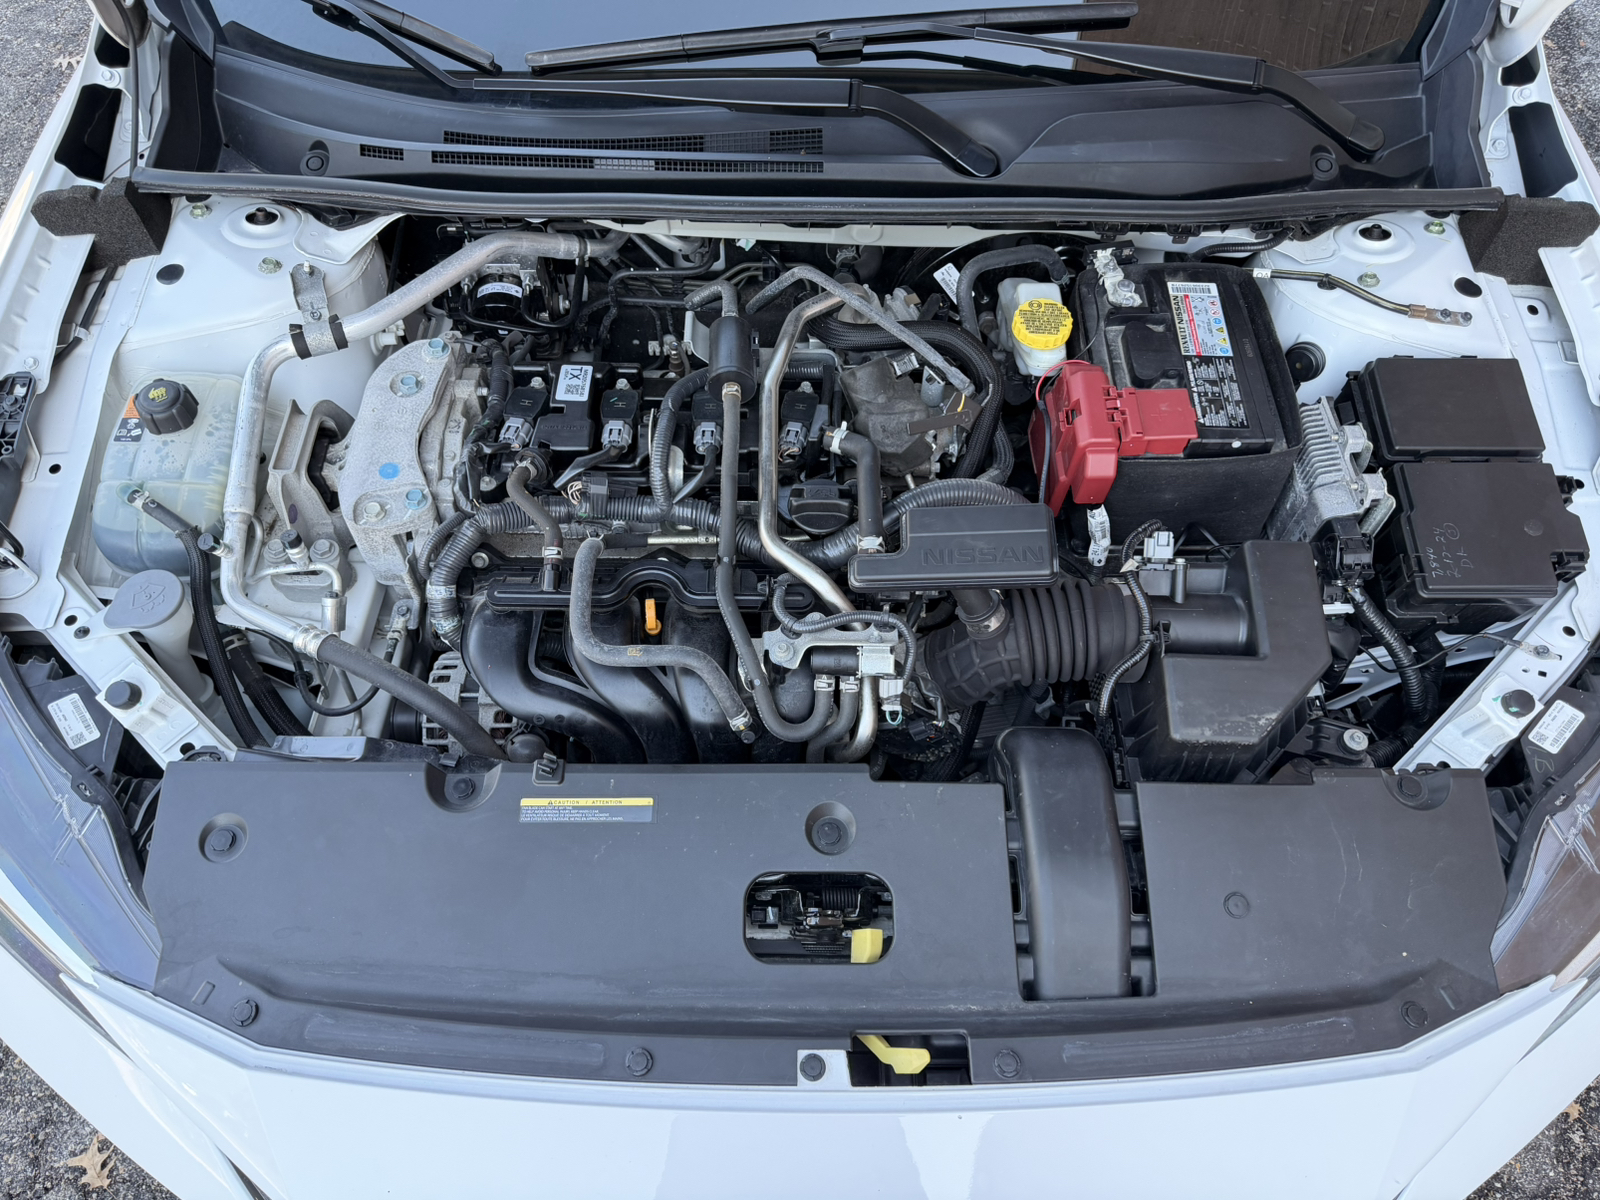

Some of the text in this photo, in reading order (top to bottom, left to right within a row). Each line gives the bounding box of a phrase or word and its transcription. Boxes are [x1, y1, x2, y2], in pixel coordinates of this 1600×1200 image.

[1172, 295, 1184, 325] NISSAN
[1179, 326, 1191, 354] RENAULT
[568, 366, 584, 381] TX
[921, 545, 1044, 566] NISSAN
